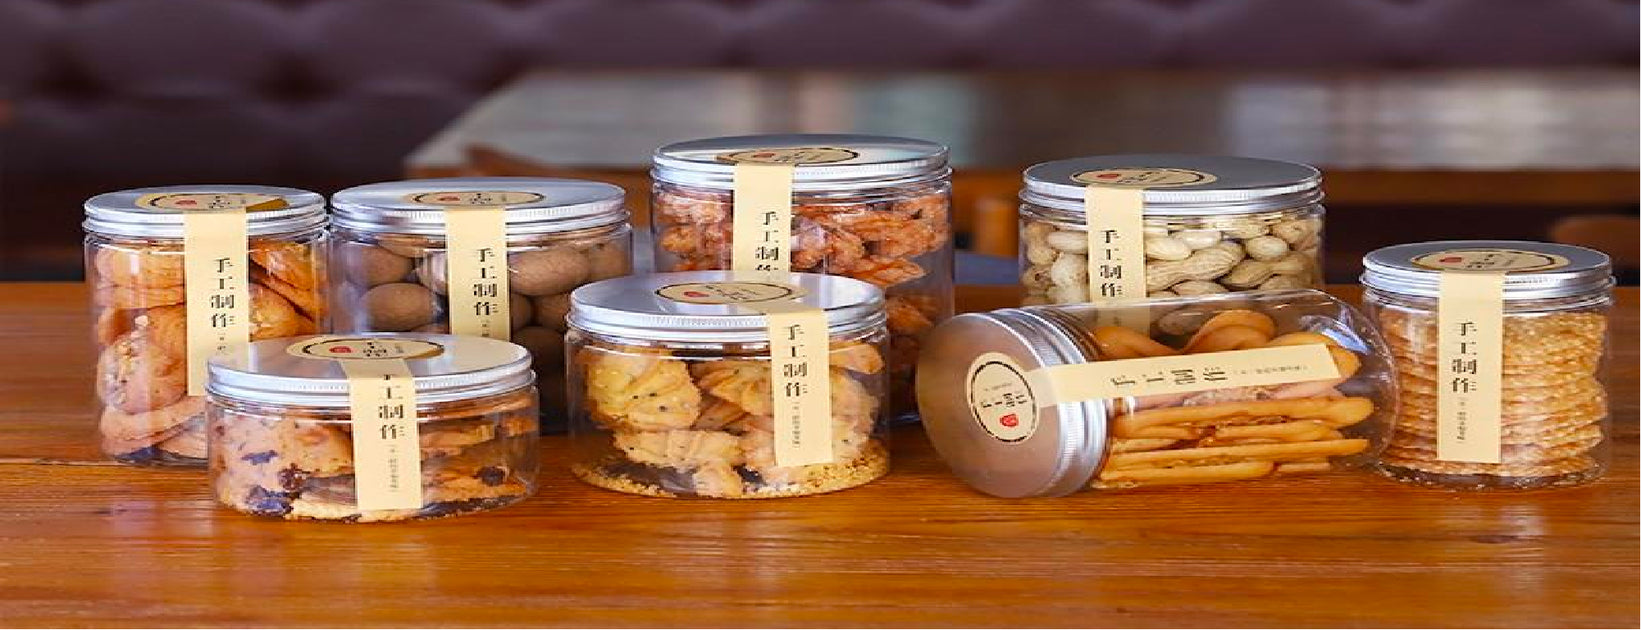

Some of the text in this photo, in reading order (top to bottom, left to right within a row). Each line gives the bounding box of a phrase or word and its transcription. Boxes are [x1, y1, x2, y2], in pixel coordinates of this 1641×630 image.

[209, 257, 236, 329] 手工制作
[473, 247, 499, 316] 手工制作
[1100, 229, 1123, 298] 手工制作
[783, 323, 809, 398] 手工制作
[1451, 321, 1478, 394] 手工制作
